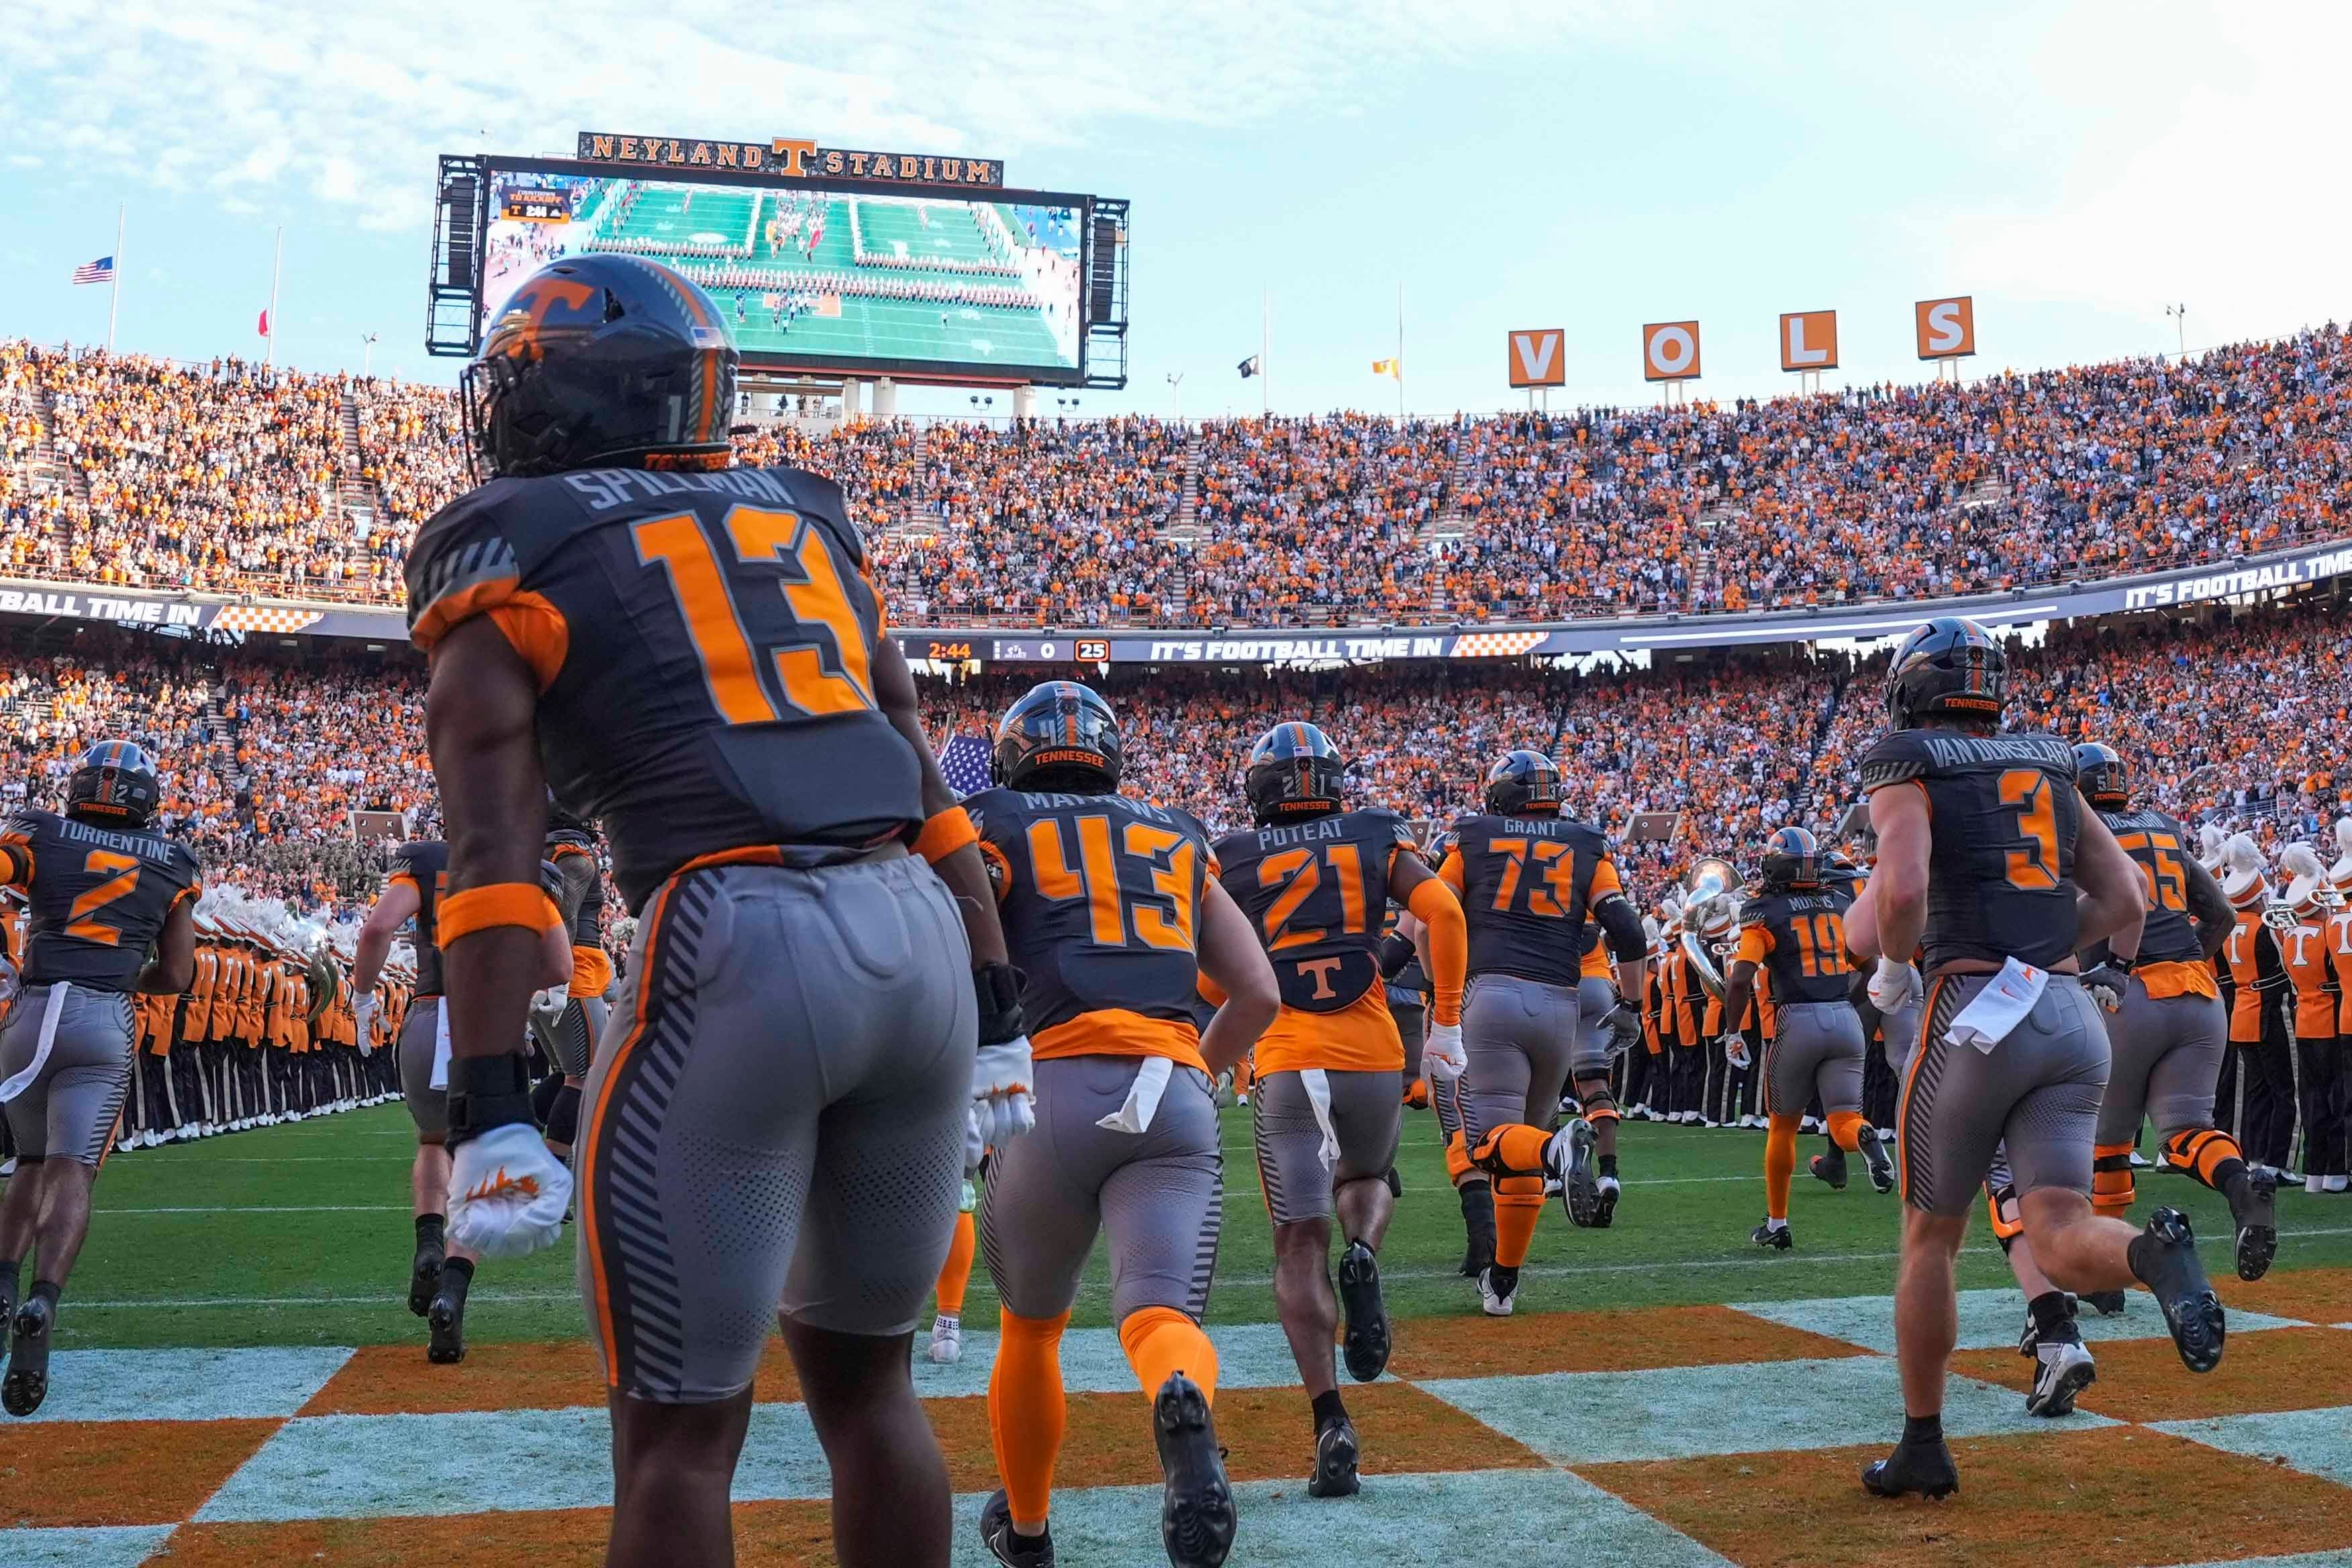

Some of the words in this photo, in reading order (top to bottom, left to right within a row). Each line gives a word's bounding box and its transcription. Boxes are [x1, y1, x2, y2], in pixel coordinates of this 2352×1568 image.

[592, 136, 762, 168] NEYLAND
[773, 137, 817, 177] T
[826, 151, 991, 184] STADIUM
[511, 205, 521, 215] T
[526, 205, 547, 217] 2:44
[524, 195, 563, 203] KICKOFF
[1514, 334, 1558, 379] V
[1649, 326, 1694, 373] O
[1790, 317, 1828, 363] L
[1928, 303, 1964, 351] S
[564, 469, 795, 509] SPILLMAN
[2125, 583, 2174, 609] IT'S
[2177, 562, 2303, 601] FOOTBALL
[2306, 549, 2352, 579] TIME
[0, 590, 81, 616] BALL
[88, 598, 162, 622] TIME
[166, 604, 201, 625] IN
[628, 503, 875, 725] 13
[929, 643, 971, 658] 2:44
[1040, 643, 1055, 658] 0
[1080, 644, 1105, 658] 25
[1150, 641, 1202, 660] IT'S
[1208, 640, 1342, 660] FOOTBALL
[1345, 638, 1410, 657] TIME
[1412, 638, 1442, 656] IN
[1944, 698, 2000, 712] TENNESSEE
[1035, 750, 1105, 768] TENNESSEE
[1924, 738, 1976, 769] VAN
[79, 803, 128, 816] TENNESSEE
[115, 784, 128, 803] 2
[1023, 793, 1173, 824] MATEWS
[1279, 801, 1332, 812] TENNESSEE
[59, 818, 177, 865] TURRENTINE
[1259, 818, 1343, 851] POTEAT
[1504, 819, 1558, 836] GRANT
[1996, 769, 2060, 890] 3
[63, 849, 141, 946] 2
[1026, 814, 1197, 956] 43
[1257, 844, 1367, 952] 21
[1488, 838, 1574, 918] 73
[1790, 912, 1846, 977] 19
[2230, 924, 2248, 964] T
[2288, 925, 2320, 965] T
[2333, 912, 2352, 954] T
[1297, 957, 1341, 1000] T
